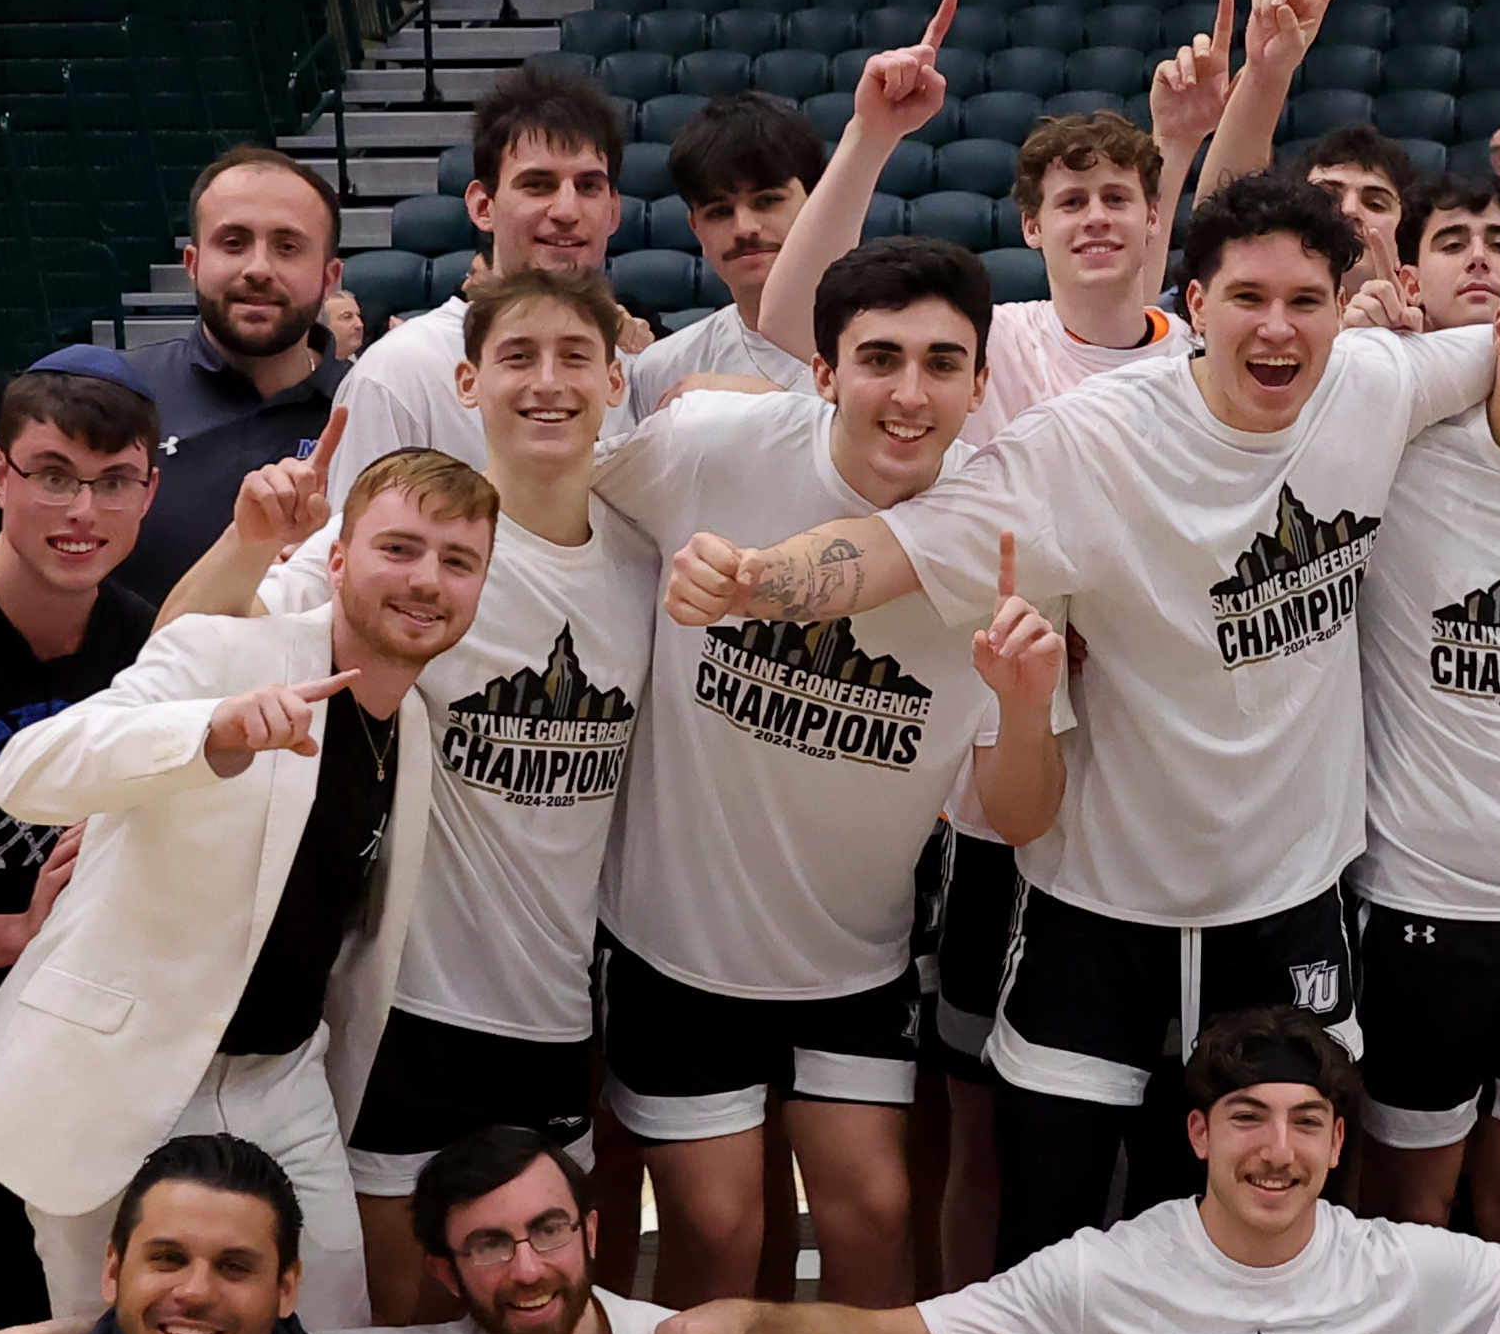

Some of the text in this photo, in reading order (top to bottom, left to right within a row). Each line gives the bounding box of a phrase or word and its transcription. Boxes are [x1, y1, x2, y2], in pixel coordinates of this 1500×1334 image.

[1211, 529, 1379, 615] SKYLINE CONFERENC
[1216, 563, 1367, 664] CHAMPION
[1282, 620, 1343, 657] 2024-2025
[702, 632, 932, 717] SKYLINE CONFERENCE
[449, 710, 534, 740] SKYLINE
[695, 660, 922, 765] CHAMPIONS
[442, 726, 625, 794] CHAMPIONS
[753, 729, 837, 761] 2024-2025
[503, 791, 576, 807] 2024-2025
[1289, 960, 1342, 1015] YU
